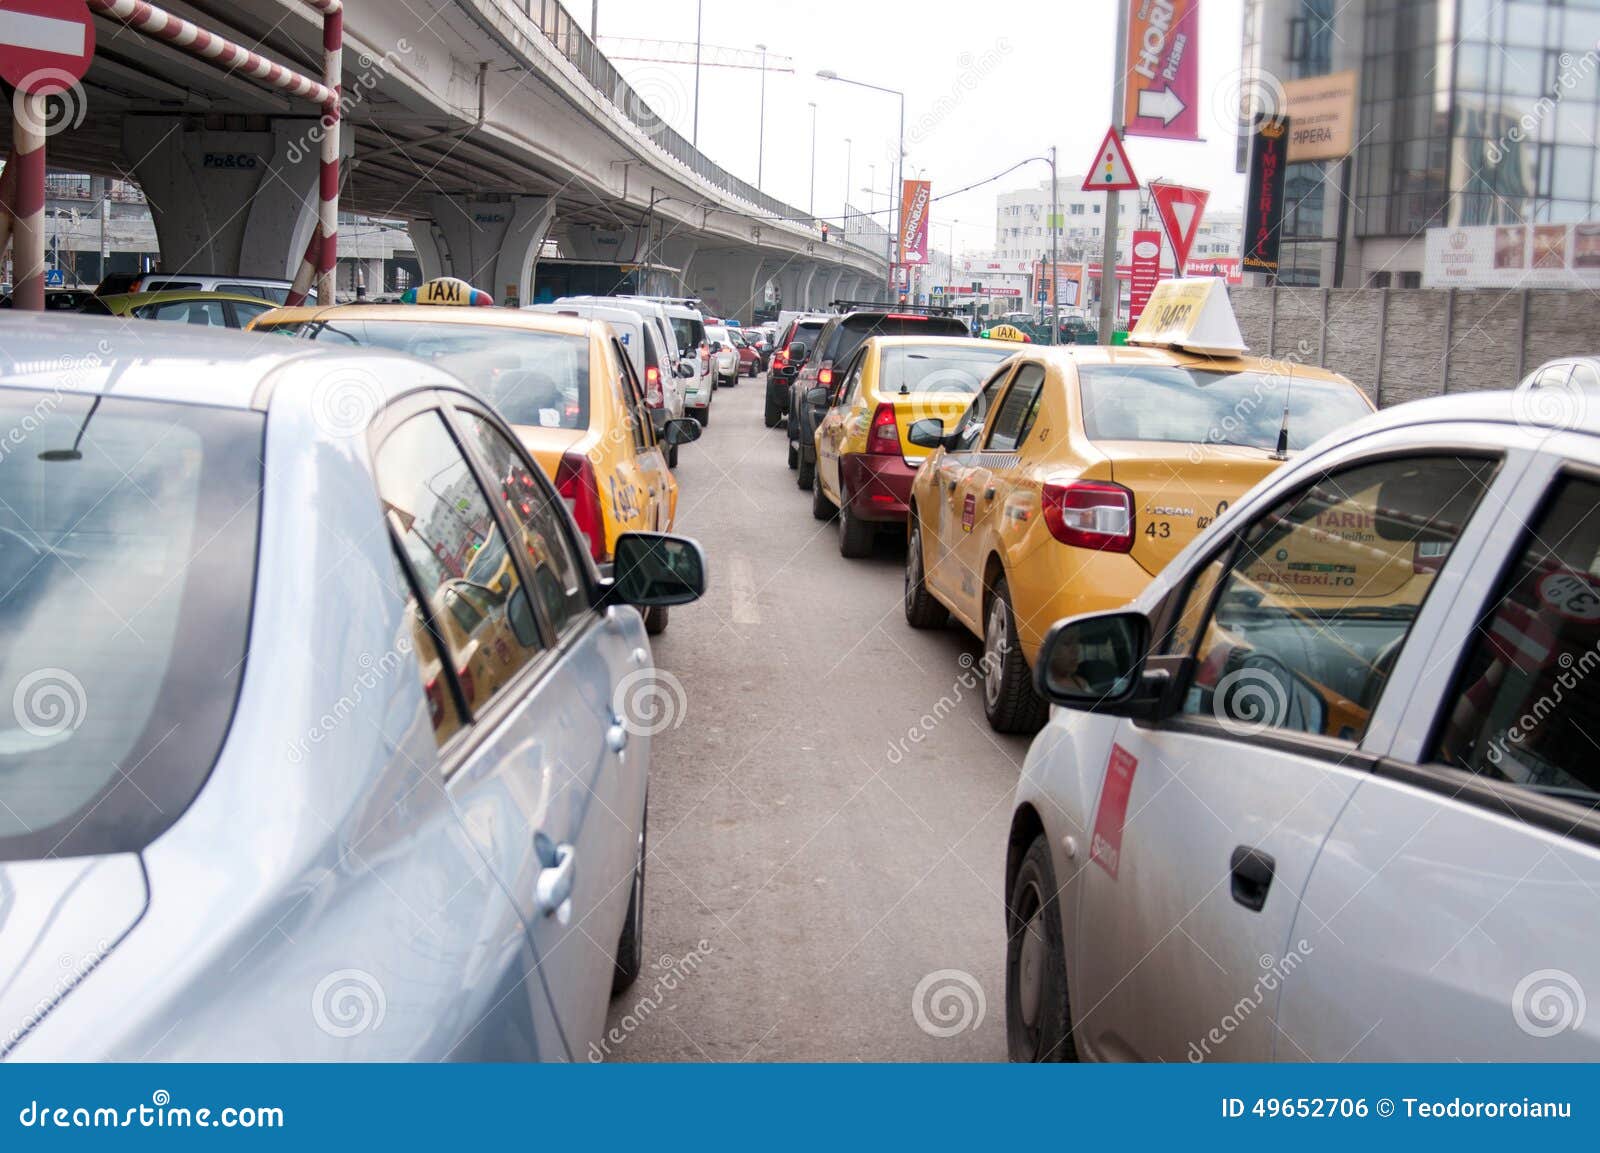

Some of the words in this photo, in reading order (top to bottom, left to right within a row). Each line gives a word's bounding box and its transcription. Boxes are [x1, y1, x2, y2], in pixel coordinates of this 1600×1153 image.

[1292, 128, 1333, 144] PIPERA
[203, 154, 257, 168] Pa&Co
[1256, 139, 1278, 255] IMPERIAL
[904, 189, 929, 248] HORNBACH
[1243, 257, 1278, 269] Ballroom
[428, 281, 461, 301] TAXI
[997, 327, 1017, 339] TAXI
[1145, 521, 1171, 538] 43
